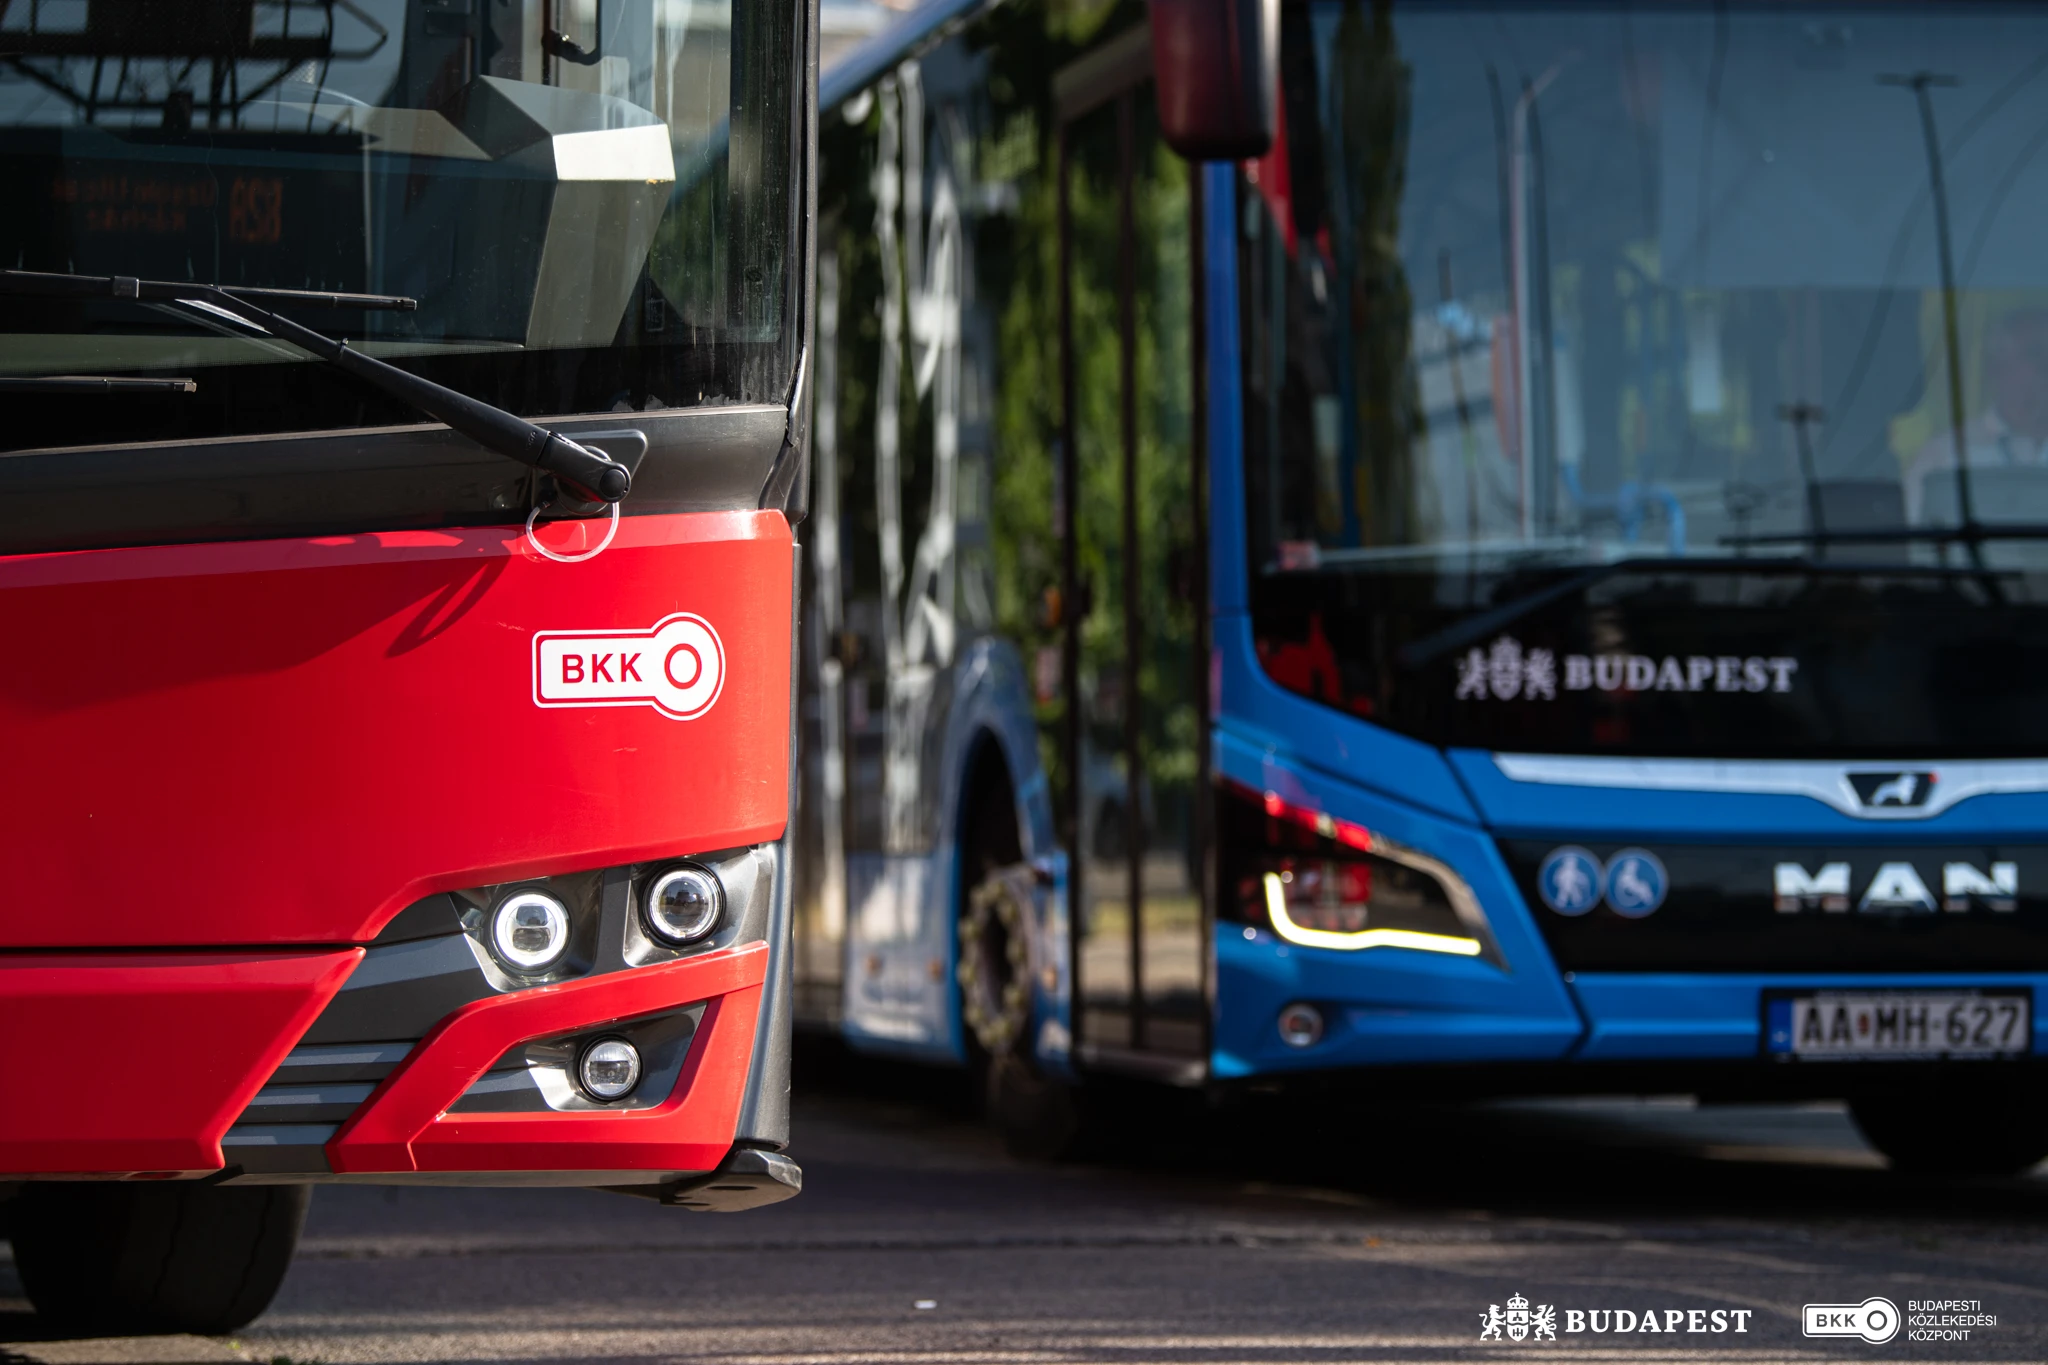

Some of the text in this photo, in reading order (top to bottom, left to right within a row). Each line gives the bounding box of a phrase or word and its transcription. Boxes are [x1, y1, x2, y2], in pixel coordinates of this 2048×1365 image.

[562, 653, 642, 683] BKK
[1564, 654, 1799, 693] BUDAPEST
[1773, 861, 2018, 912] MAN
[1802, 1004, 2019, 1045] AA MH-627
